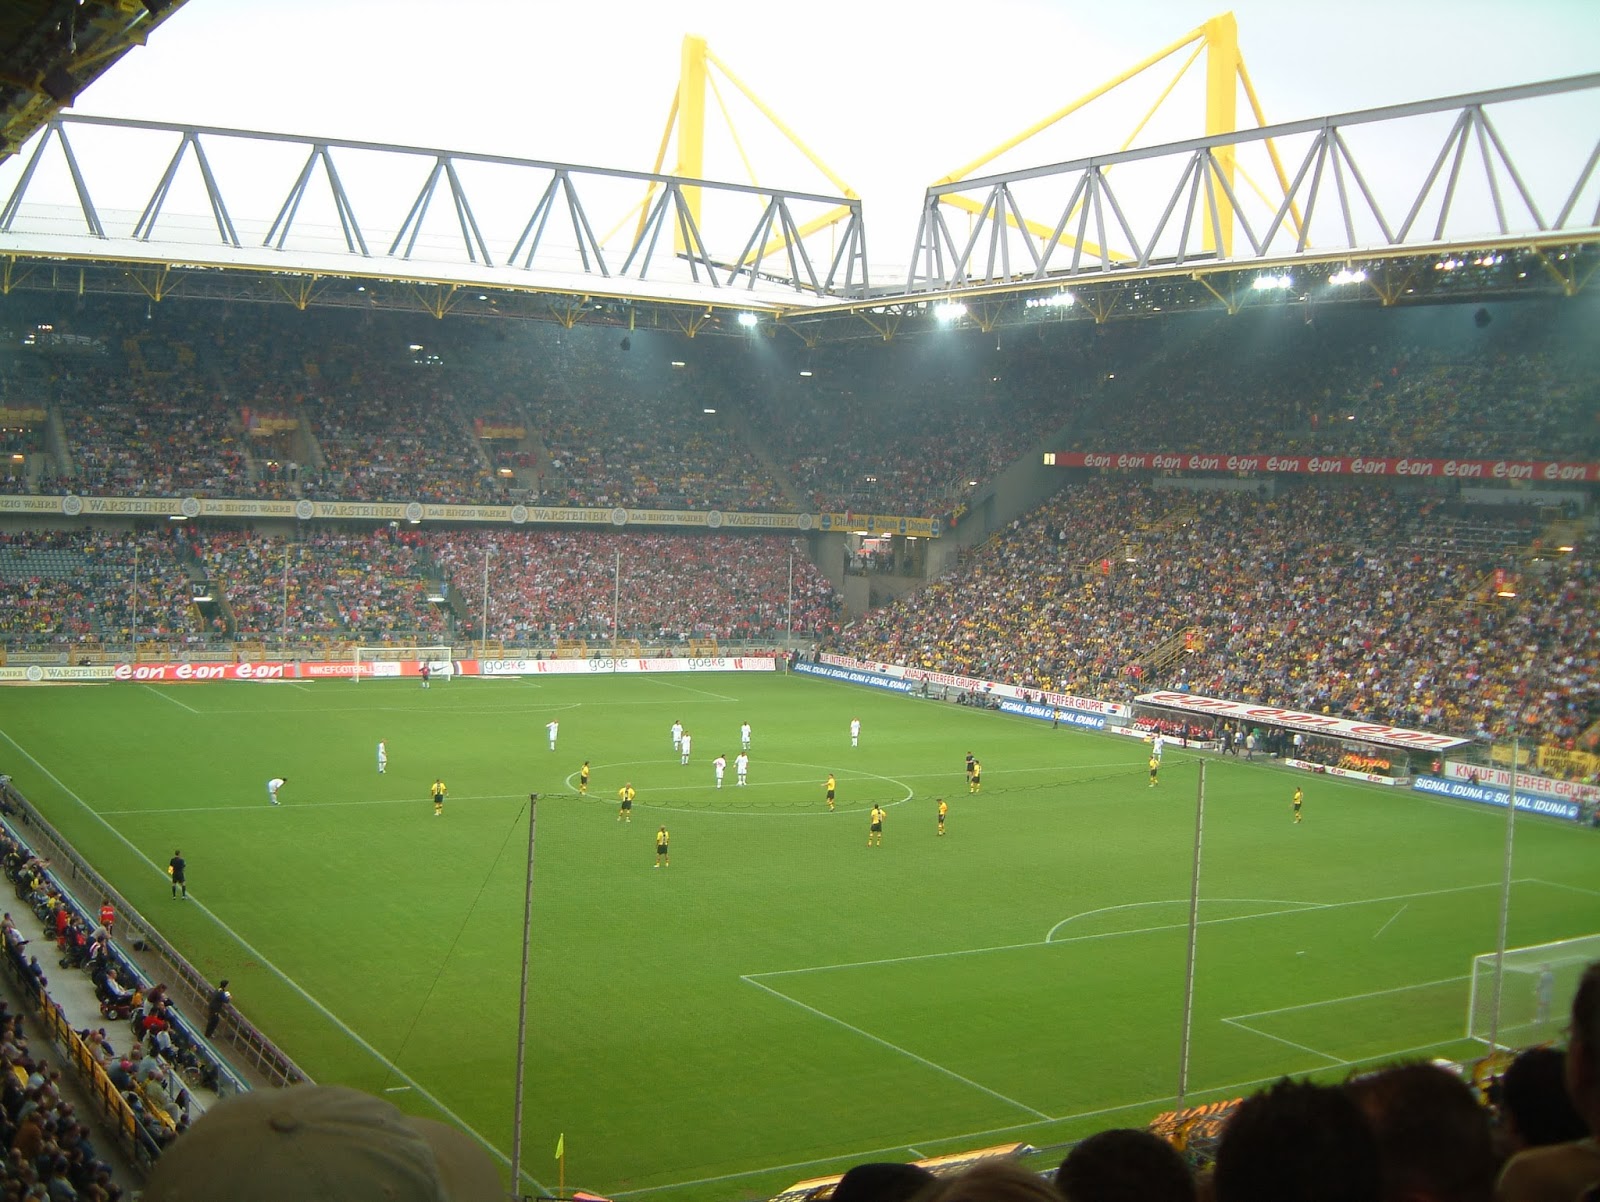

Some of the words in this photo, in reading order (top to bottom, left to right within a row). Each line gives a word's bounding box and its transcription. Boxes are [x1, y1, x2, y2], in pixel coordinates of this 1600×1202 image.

[90, 500, 177, 512] WARSTEINER
[205, 504, 222, 512] DAS
[225, 504, 257, 512] EINZIG
[260, 504, 291, 513] WAHRE
[321, 504, 400, 516] WARSTEINER
[428, 508, 444, 516] DAS
[446, 509, 475, 517] EINZIG
[477, 509, 507, 518] WAHRE
[533, 509, 607, 521] WARSTEINER
[727, 514, 795, 526] WARSTEINER
[485, 660, 526, 673] goeke
[589, 658, 628, 671] goeke
[688, 657, 726, 670] goeke
[48, 668, 115, 678] WARSTEINER
[869, 676, 889, 687] SIGNAL
[888, 679, 906, 690] IDUNA
[956, 677, 981, 690] GRUPPE
[1076, 698, 1104, 712] GRUPPE
[1001, 701, 1024, 714] SIGNAL
[1024, 705, 1045, 717] IDUNA
[1075, 714, 1098, 726] IDUNA
[1456, 764, 1494, 782] KNAUF
[1496, 771, 1551, 792] INERFER
[1414, 777, 1450, 794] SIGNAL
[1451, 784, 1483, 800] IDUNA
[1534, 798, 1568, 815] IDUNA
